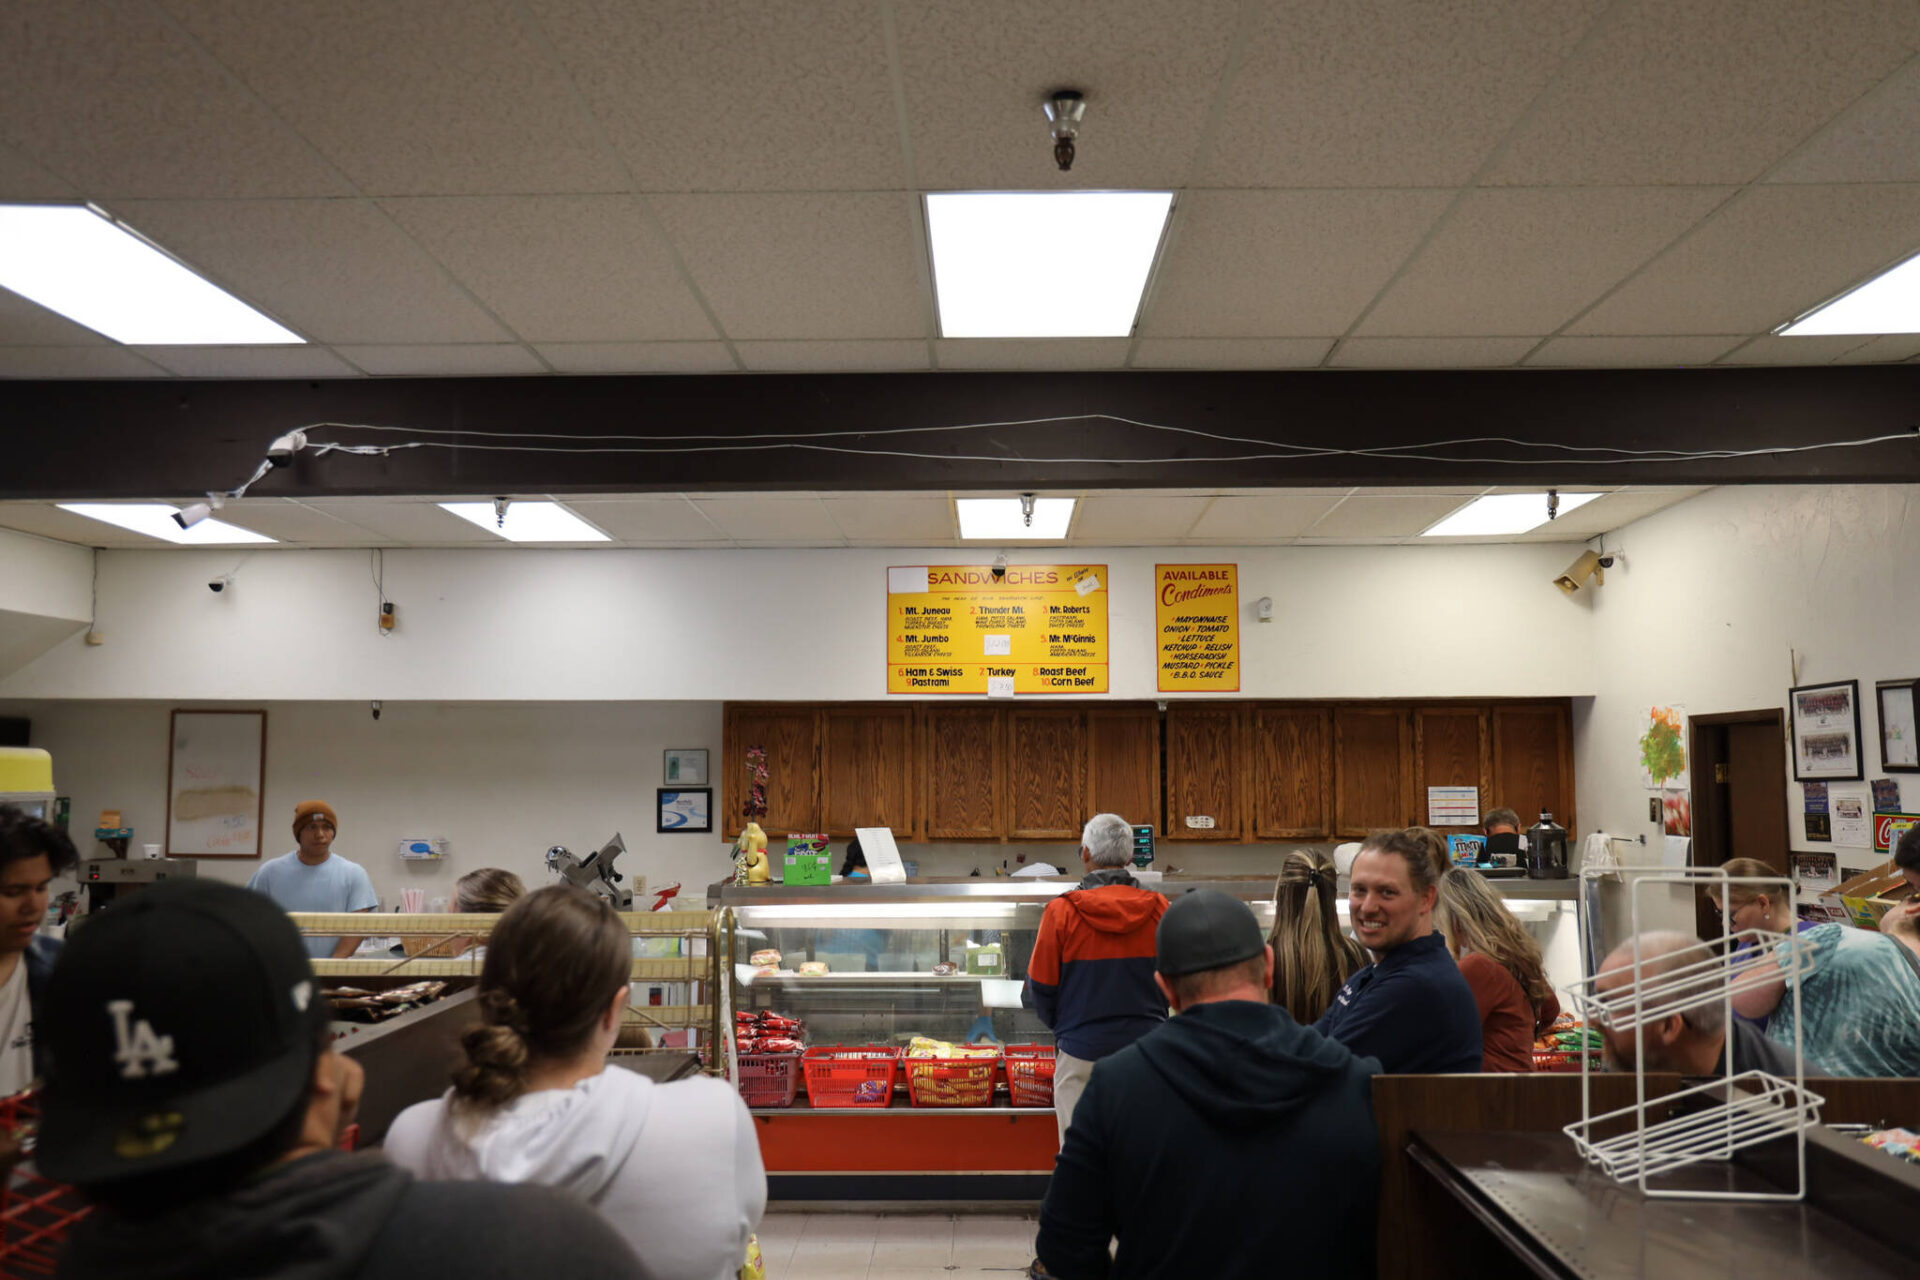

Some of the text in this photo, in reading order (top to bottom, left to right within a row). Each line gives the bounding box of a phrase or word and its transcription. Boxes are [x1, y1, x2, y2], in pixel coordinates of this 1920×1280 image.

[928, 572, 1059, 585] SANDWICHES
[1163, 571, 1229, 580] AVAILABLE
[1161, 583, 1232, 607] Condiments
[921, 607, 951, 615] Juneau
[979, 606, 1010, 614] Thunder
[1063, 605, 1090, 614] Roberts
[1163, 625, 1190, 633] ONION
[921, 634, 949, 643] Jumbo
[1180, 634, 1215, 642] LETTUCE
[1204, 643, 1233, 651] RELISH
[1204, 661, 1234, 669] PICKLE
[905, 667, 927, 676] Ham
[936, 667, 963, 676] Swiss
[987, 667, 1016, 677] Turkey
[1040, 667, 1064, 676] Roast
[1066, 667, 1087, 676] Beef
[1199, 671, 1225, 679] SAUCE
[912, 677, 950, 687] Pastrami
[1051, 677, 1073, 686] Corn
[1074, 677, 1095, 686] Beef
[107, 1000, 179, 1078] LA
